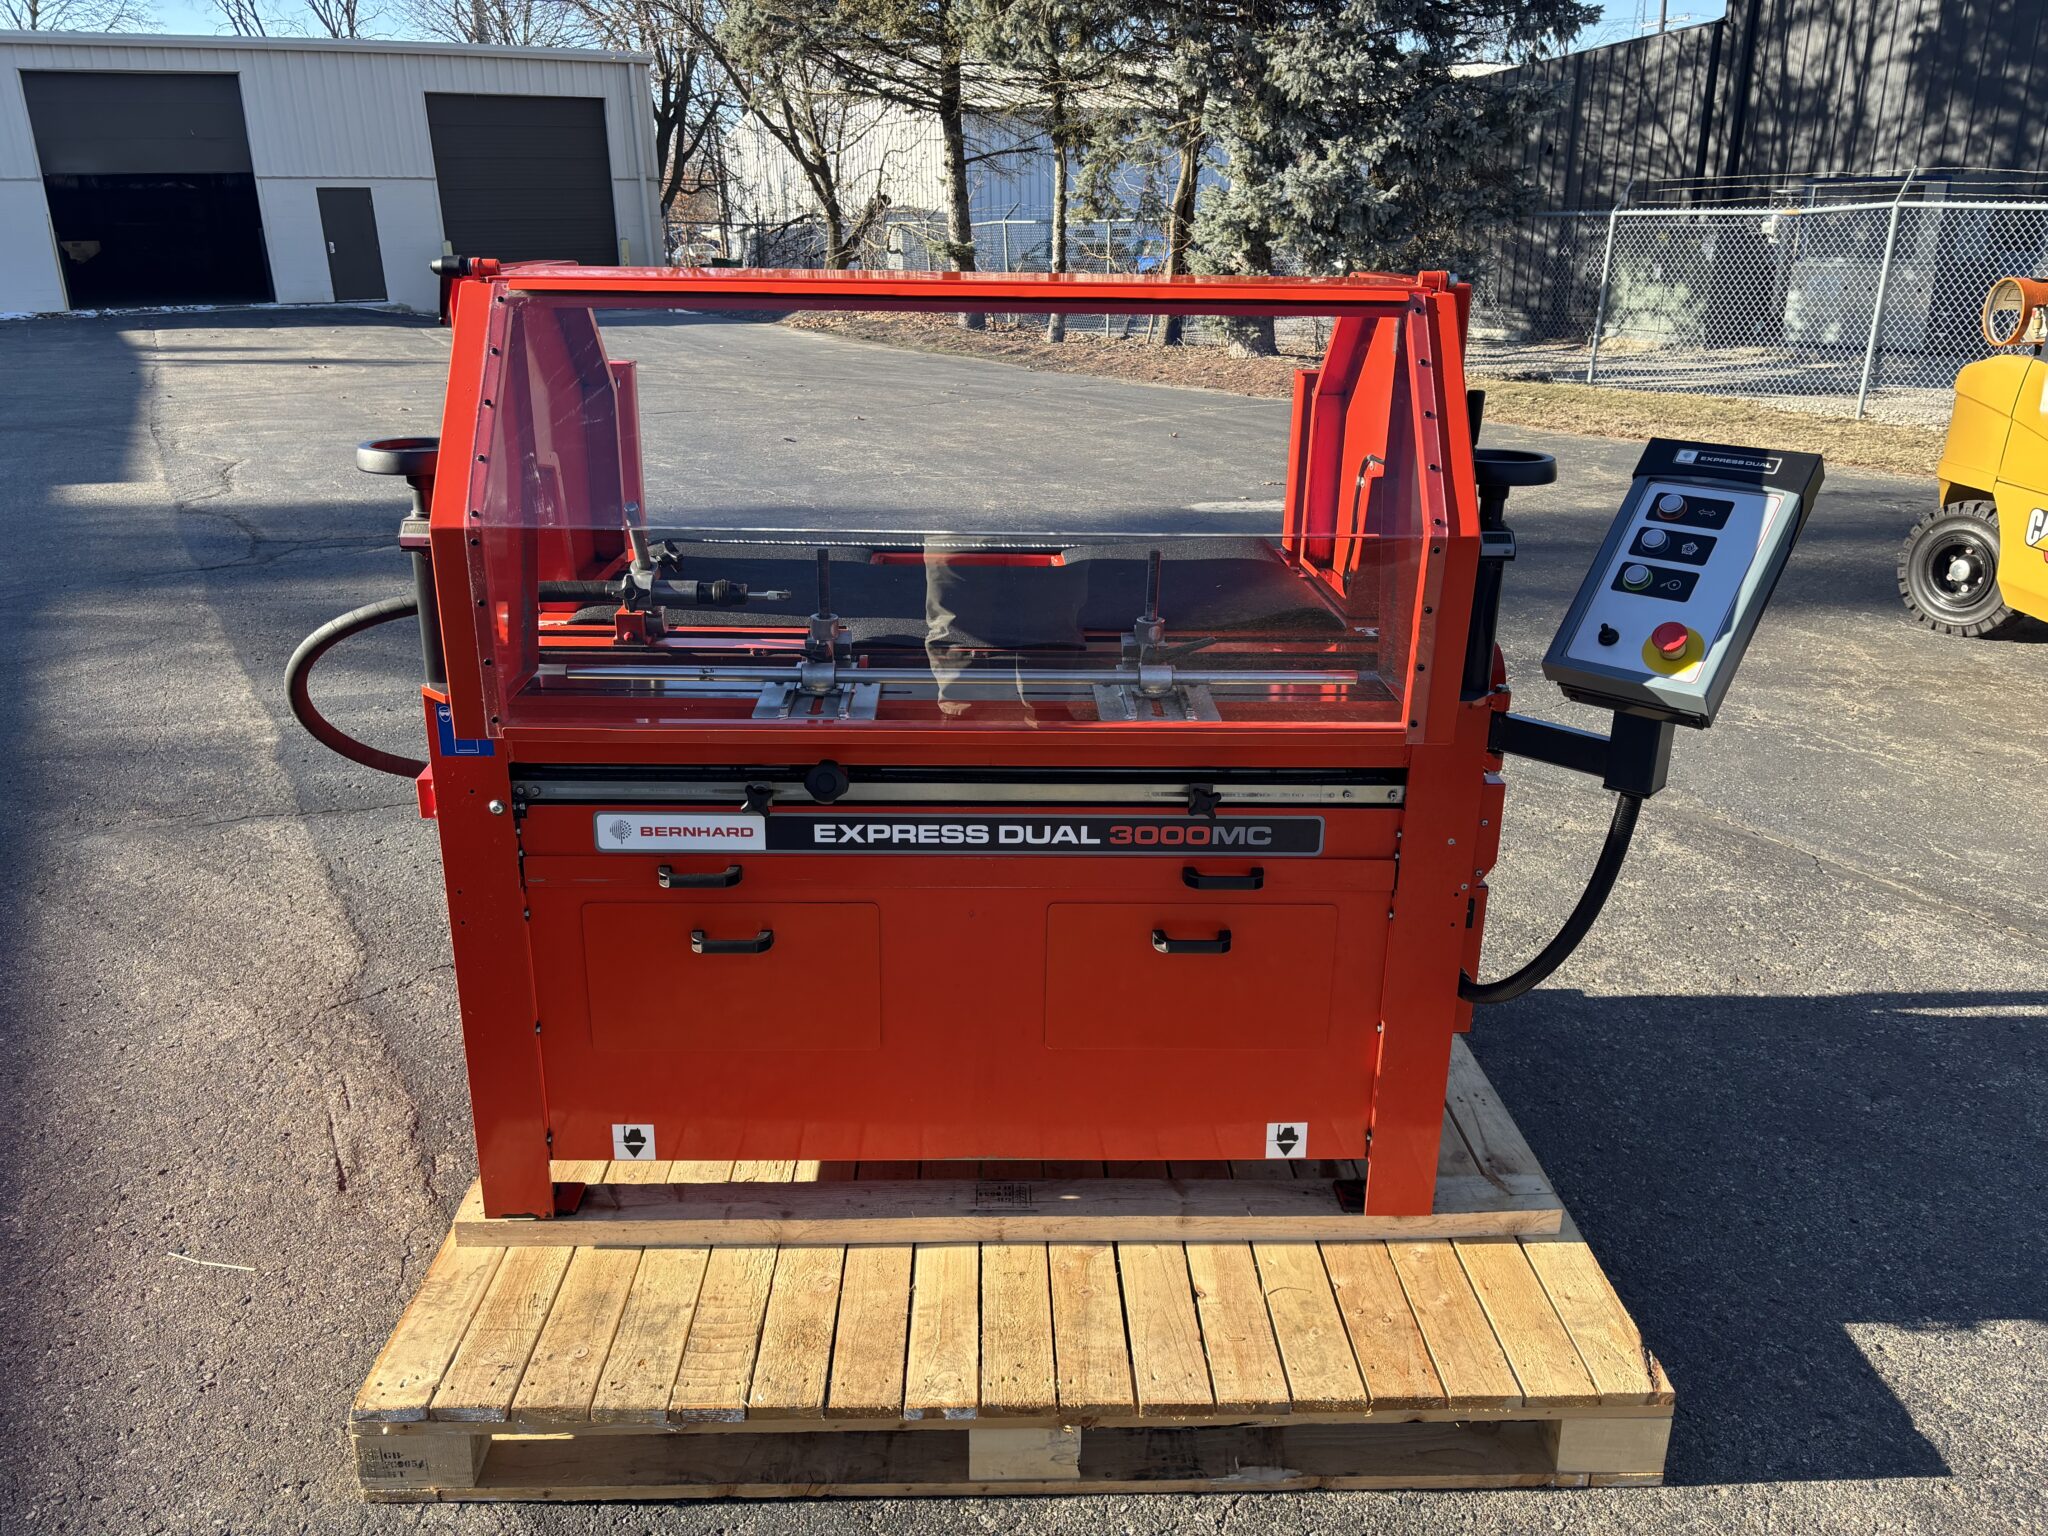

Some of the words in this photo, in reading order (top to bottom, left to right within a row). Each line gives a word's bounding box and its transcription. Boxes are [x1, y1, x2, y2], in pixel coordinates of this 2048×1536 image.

[1700, 456, 1744, 464] EXPRESS
[639, 826, 754, 838] BERNHARD
[813, 823, 989, 844] EXPRESS
[998, 824, 1100, 845] DUAL
[1109, 825, 1272, 846] 3000MC
